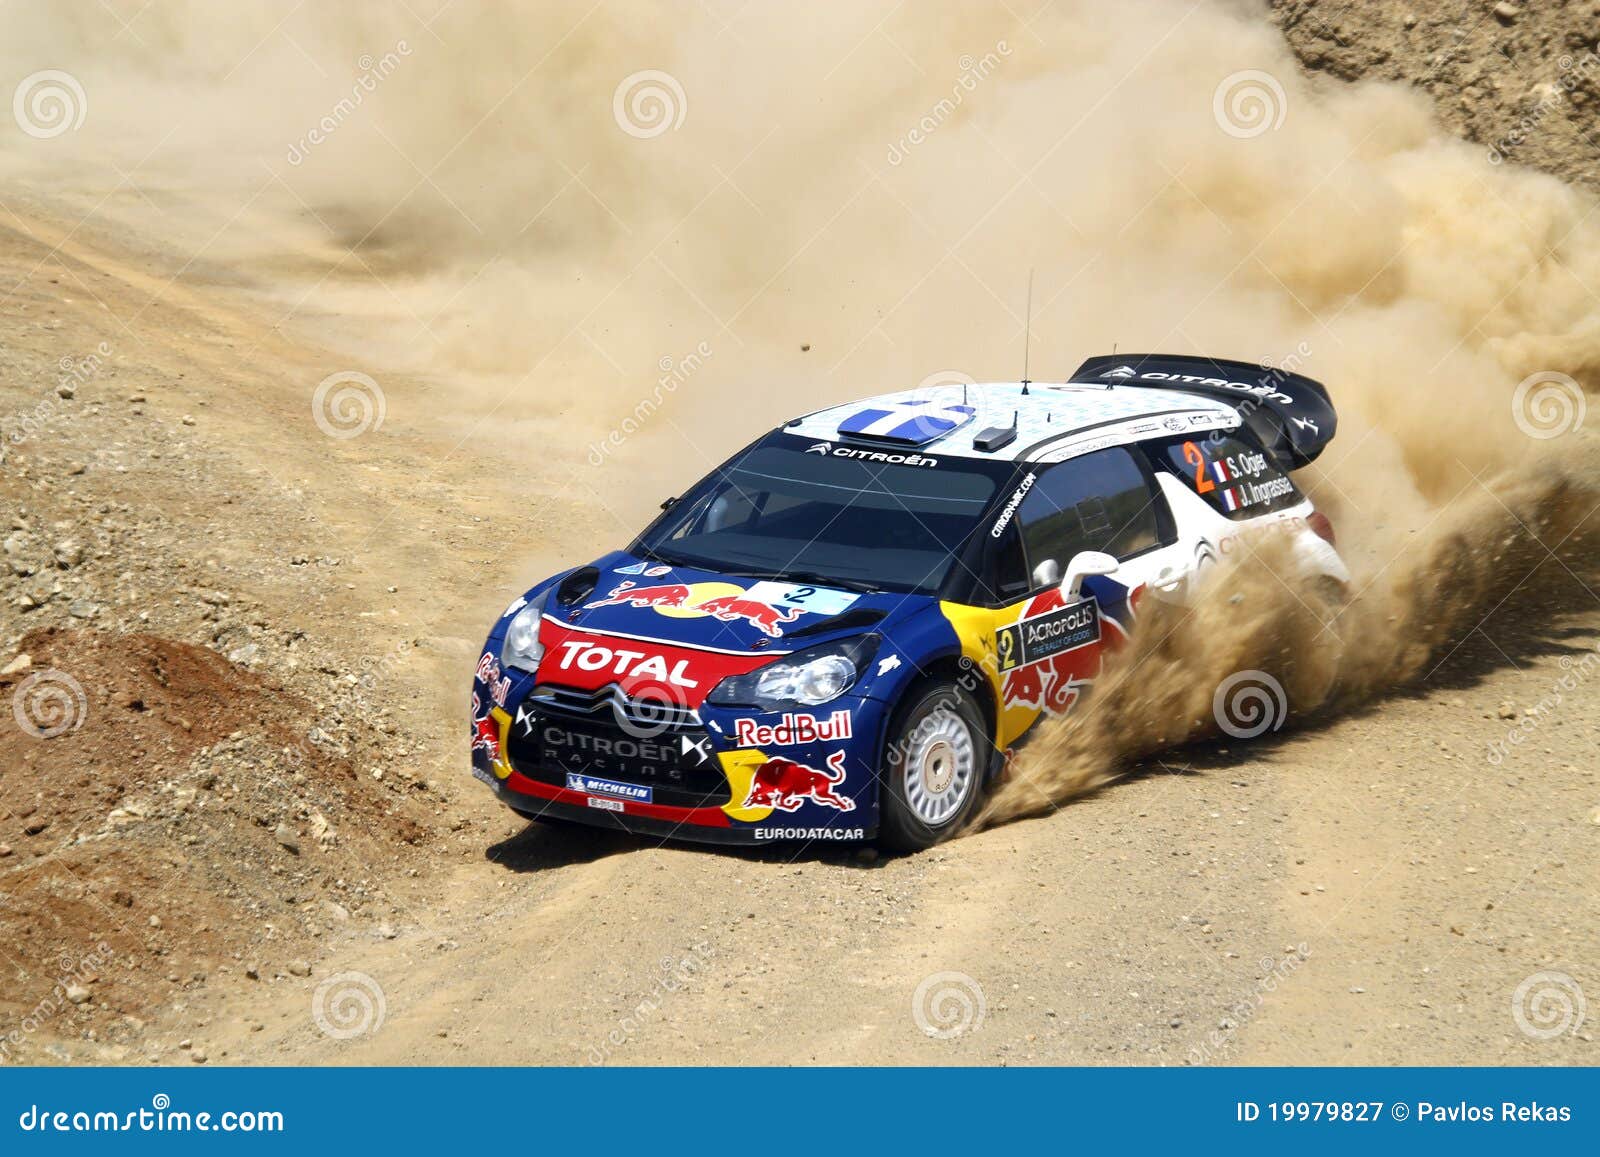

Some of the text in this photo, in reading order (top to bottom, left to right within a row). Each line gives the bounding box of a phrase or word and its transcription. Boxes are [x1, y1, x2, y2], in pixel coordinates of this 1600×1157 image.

[1183, 440, 1268, 494] 2 S. Ogier
[1239, 473, 1294, 507] J. Ingrassia
[786, 587, 817, 604] 2
[1027, 605, 1093, 645] ACROPOLIS
[560, 641, 699, 689] TOTAL
[1001, 630, 1016, 669] 2
[587, 780, 649, 798] MICHELIN
[754, 828, 864, 840] EURODATACAR
